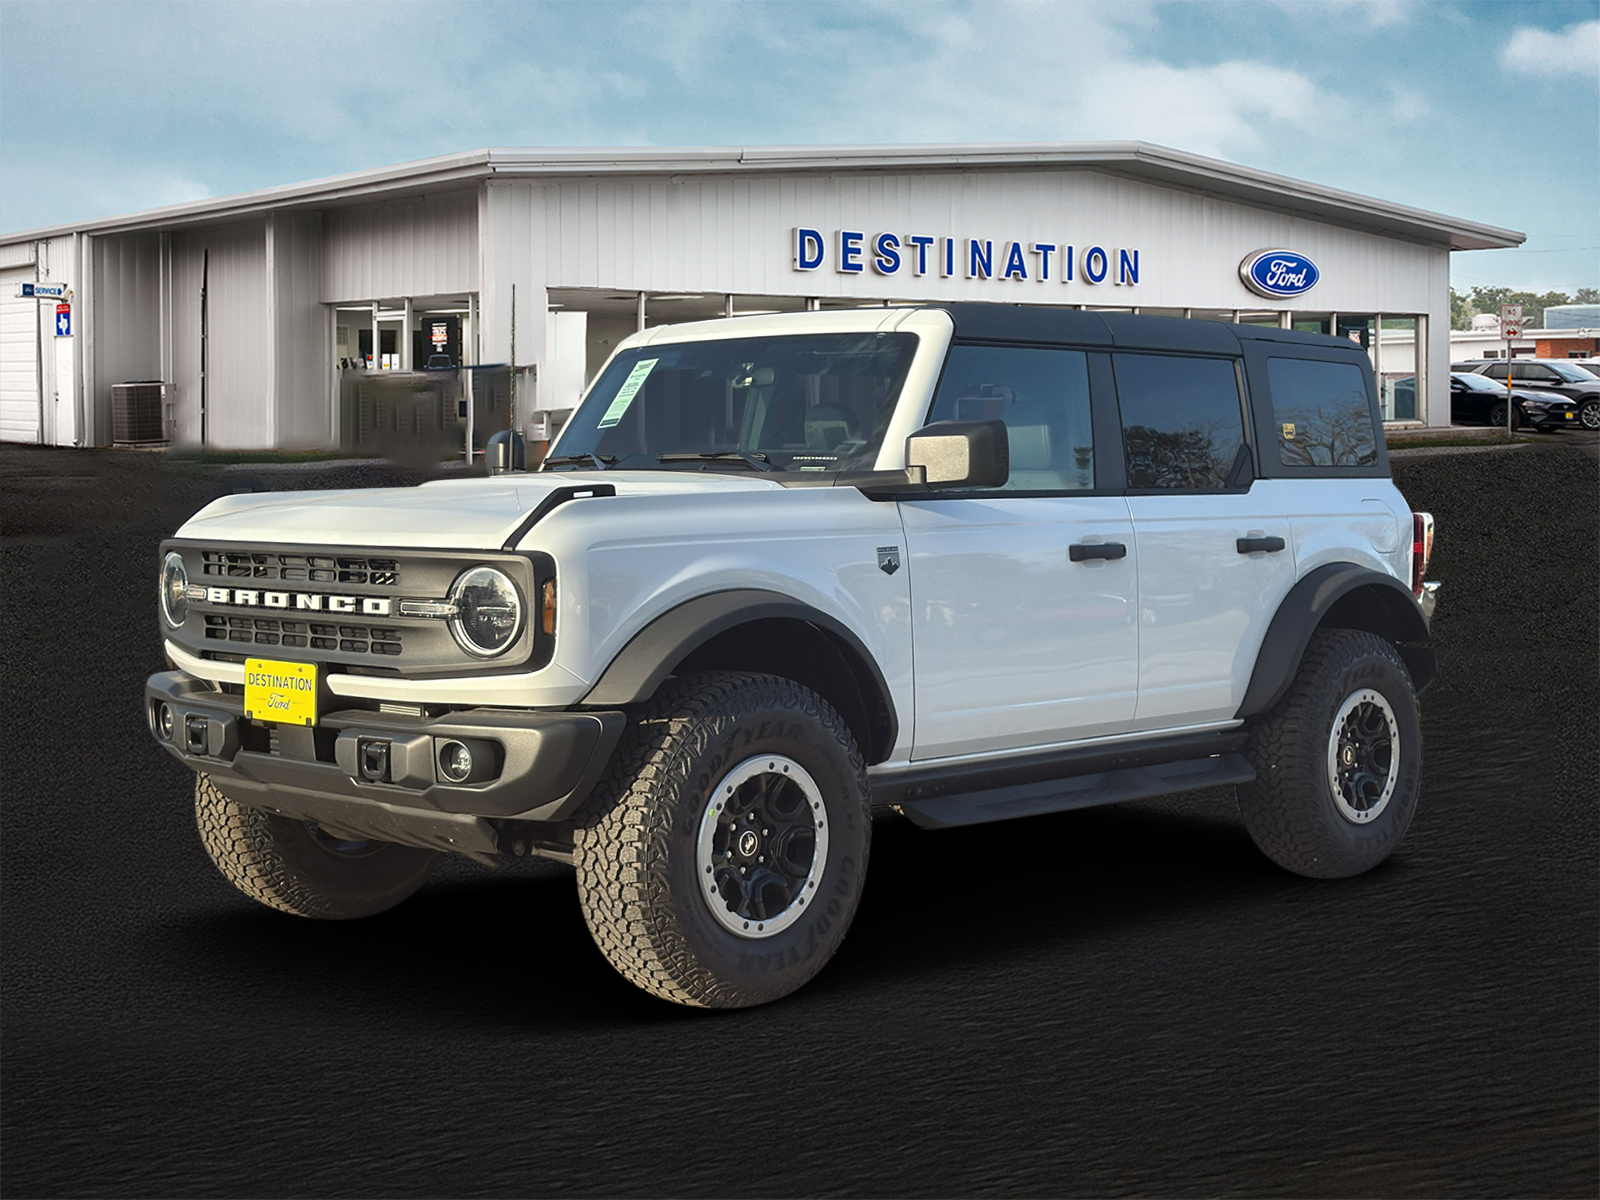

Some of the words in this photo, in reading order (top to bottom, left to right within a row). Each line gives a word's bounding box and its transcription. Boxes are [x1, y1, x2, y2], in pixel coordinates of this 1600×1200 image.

[792, 227, 1140, 286] DESTINATION
[1266, 259, 1307, 287] Ford
[35, 287, 57, 295] SERVICE
[1507, 308, 1517, 316] NO
[208, 587, 391, 614] BRONCO
[248, 672, 312, 691] DESTINATION
[267, 692, 291, 710] Ford
